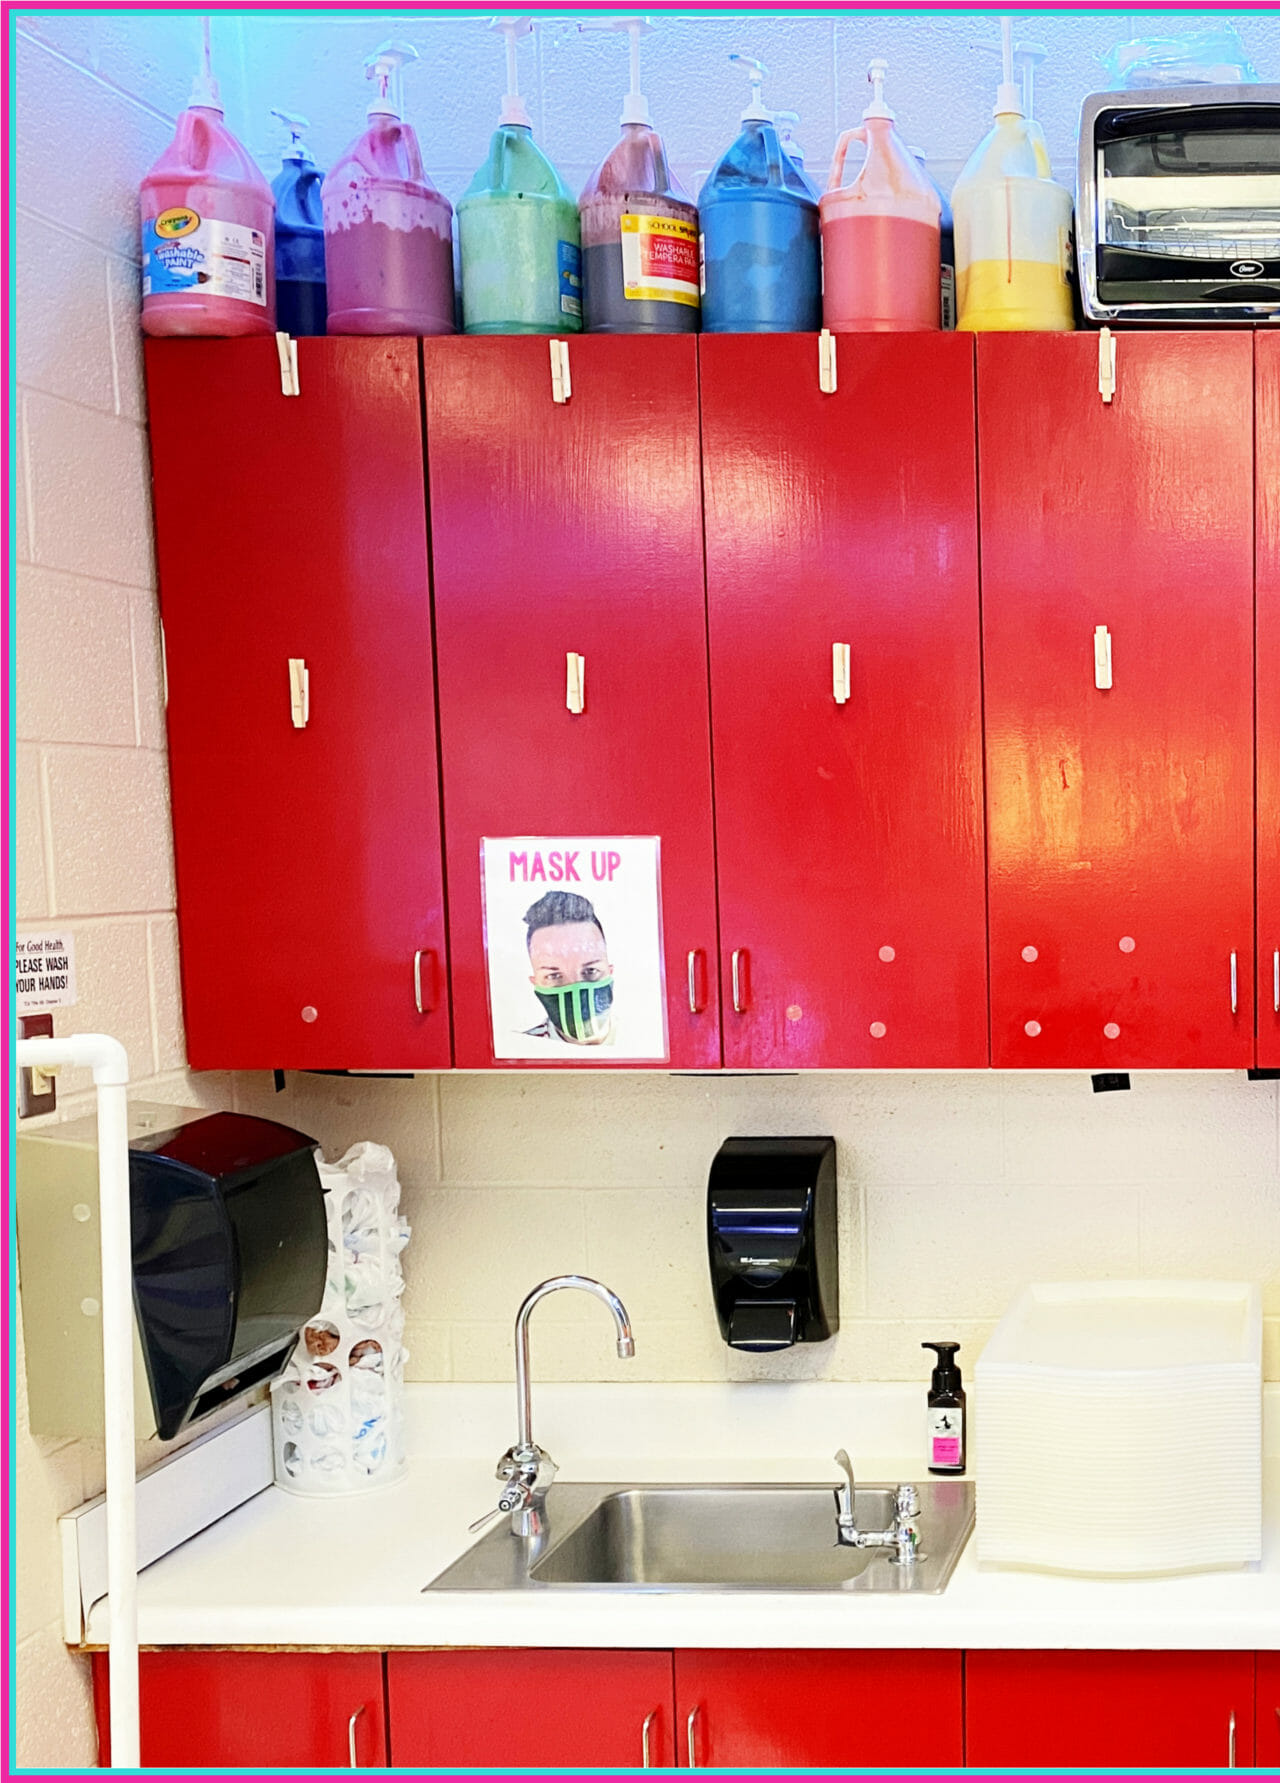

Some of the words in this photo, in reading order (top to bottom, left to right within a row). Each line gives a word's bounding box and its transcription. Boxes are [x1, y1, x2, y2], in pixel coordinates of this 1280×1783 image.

[509, 850, 582, 882] MASK
[591, 850, 622, 882] UP
[27, 940, 43, 952] Good
[45, 956, 69, 972] WASH
[39, 975, 68, 991] HANDS!
